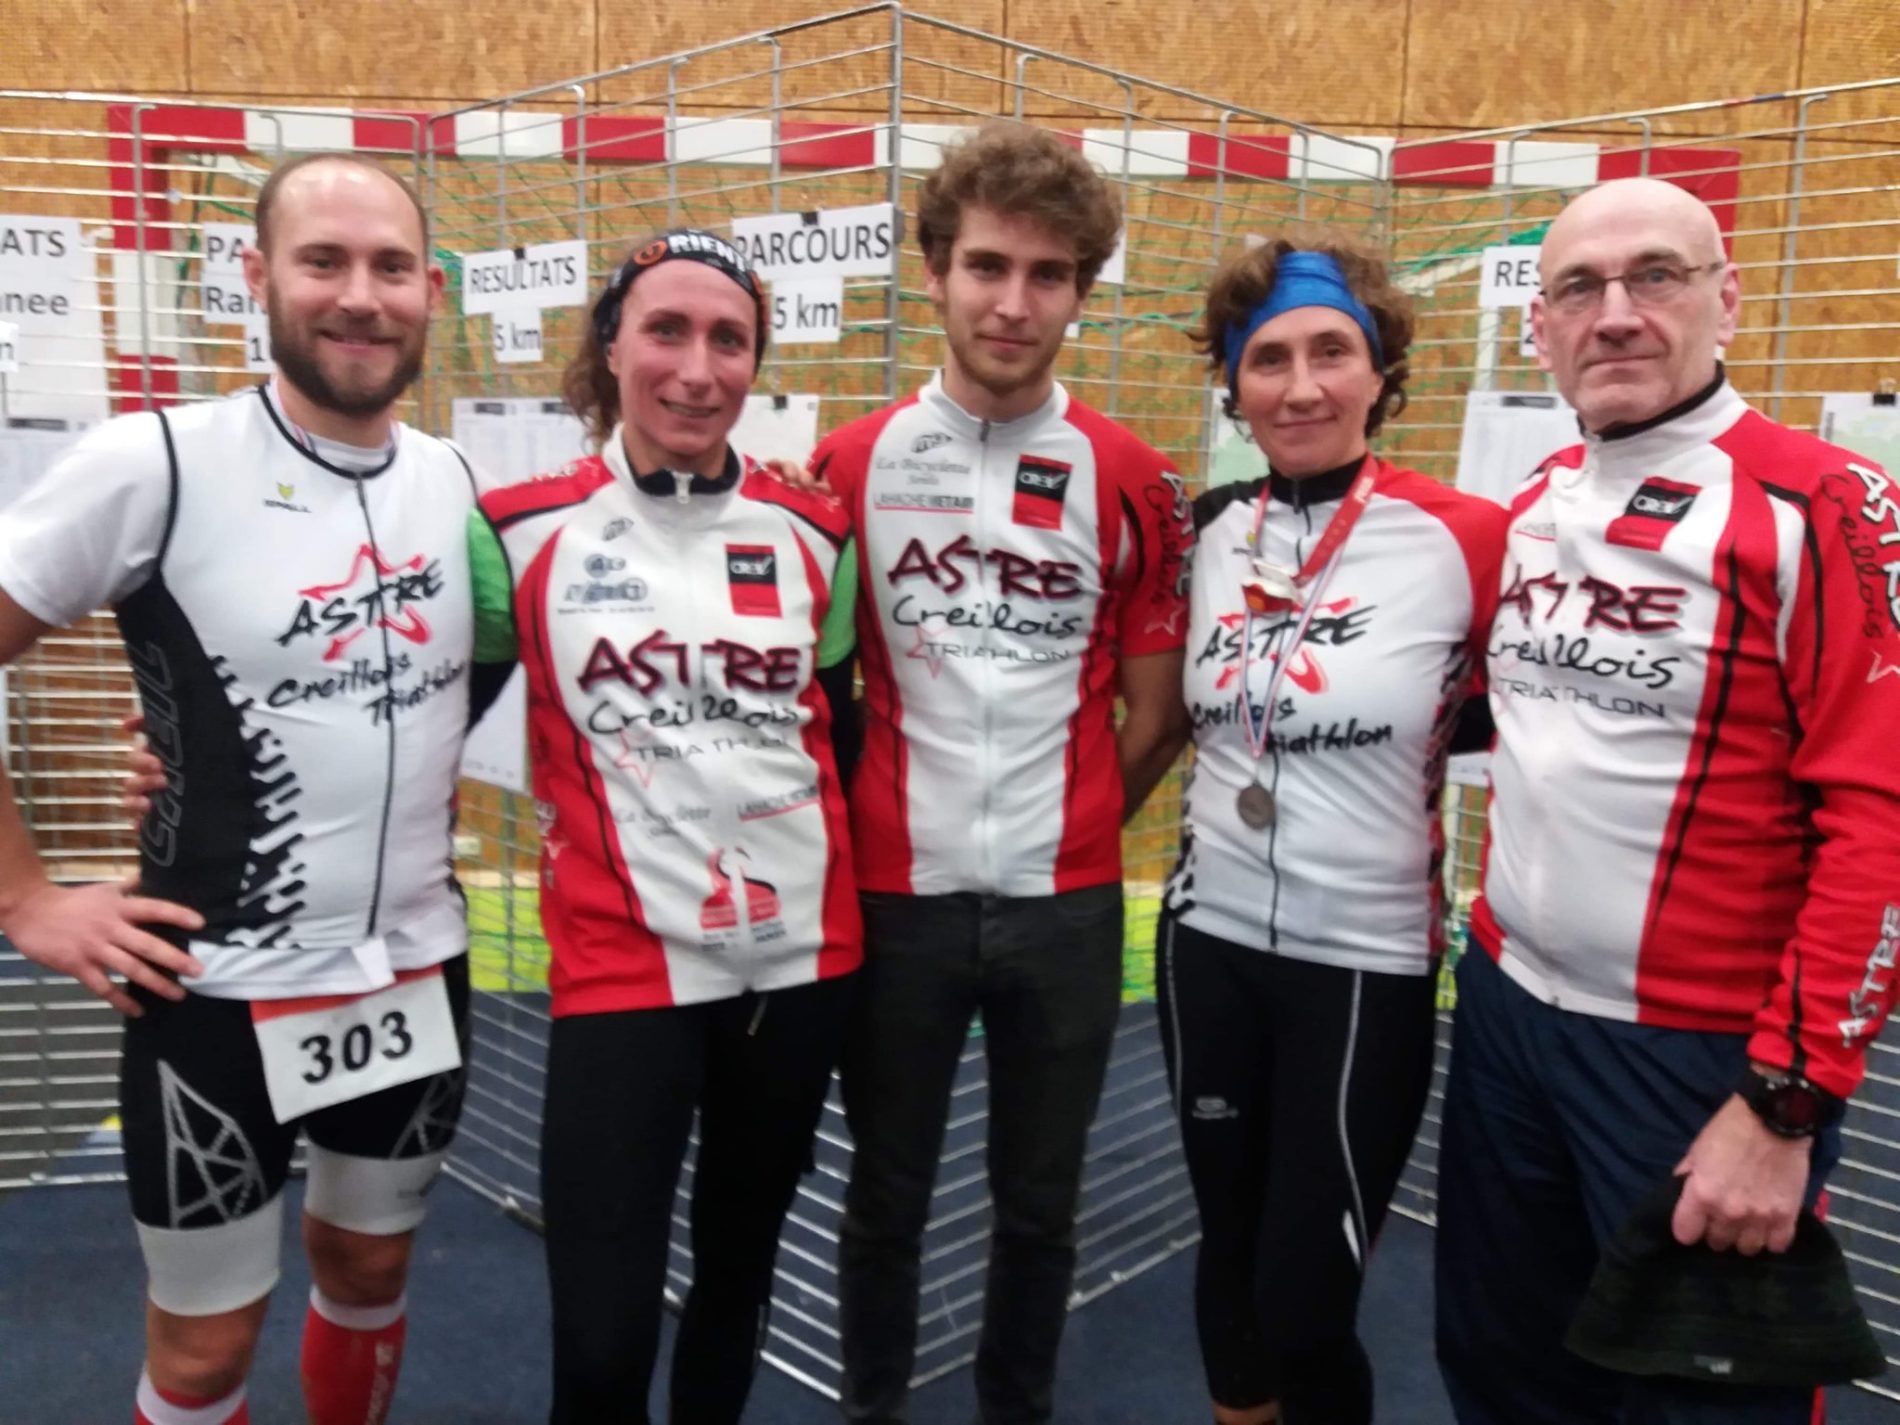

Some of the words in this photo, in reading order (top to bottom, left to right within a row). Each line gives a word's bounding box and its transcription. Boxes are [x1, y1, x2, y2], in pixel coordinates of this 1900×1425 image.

[734, 222, 890, 267] PARCOURS
[470, 256, 576, 294] RESULTATS
[772, 297, 787, 330] 5
[796, 293, 839, 329] km
[494, 324, 505, 351] 5
[510, 322, 542, 350] km
[275, 559, 445, 648] ASTRE
[576, 629, 803, 697] ASTRE
[299, 1010, 415, 1085] 303
